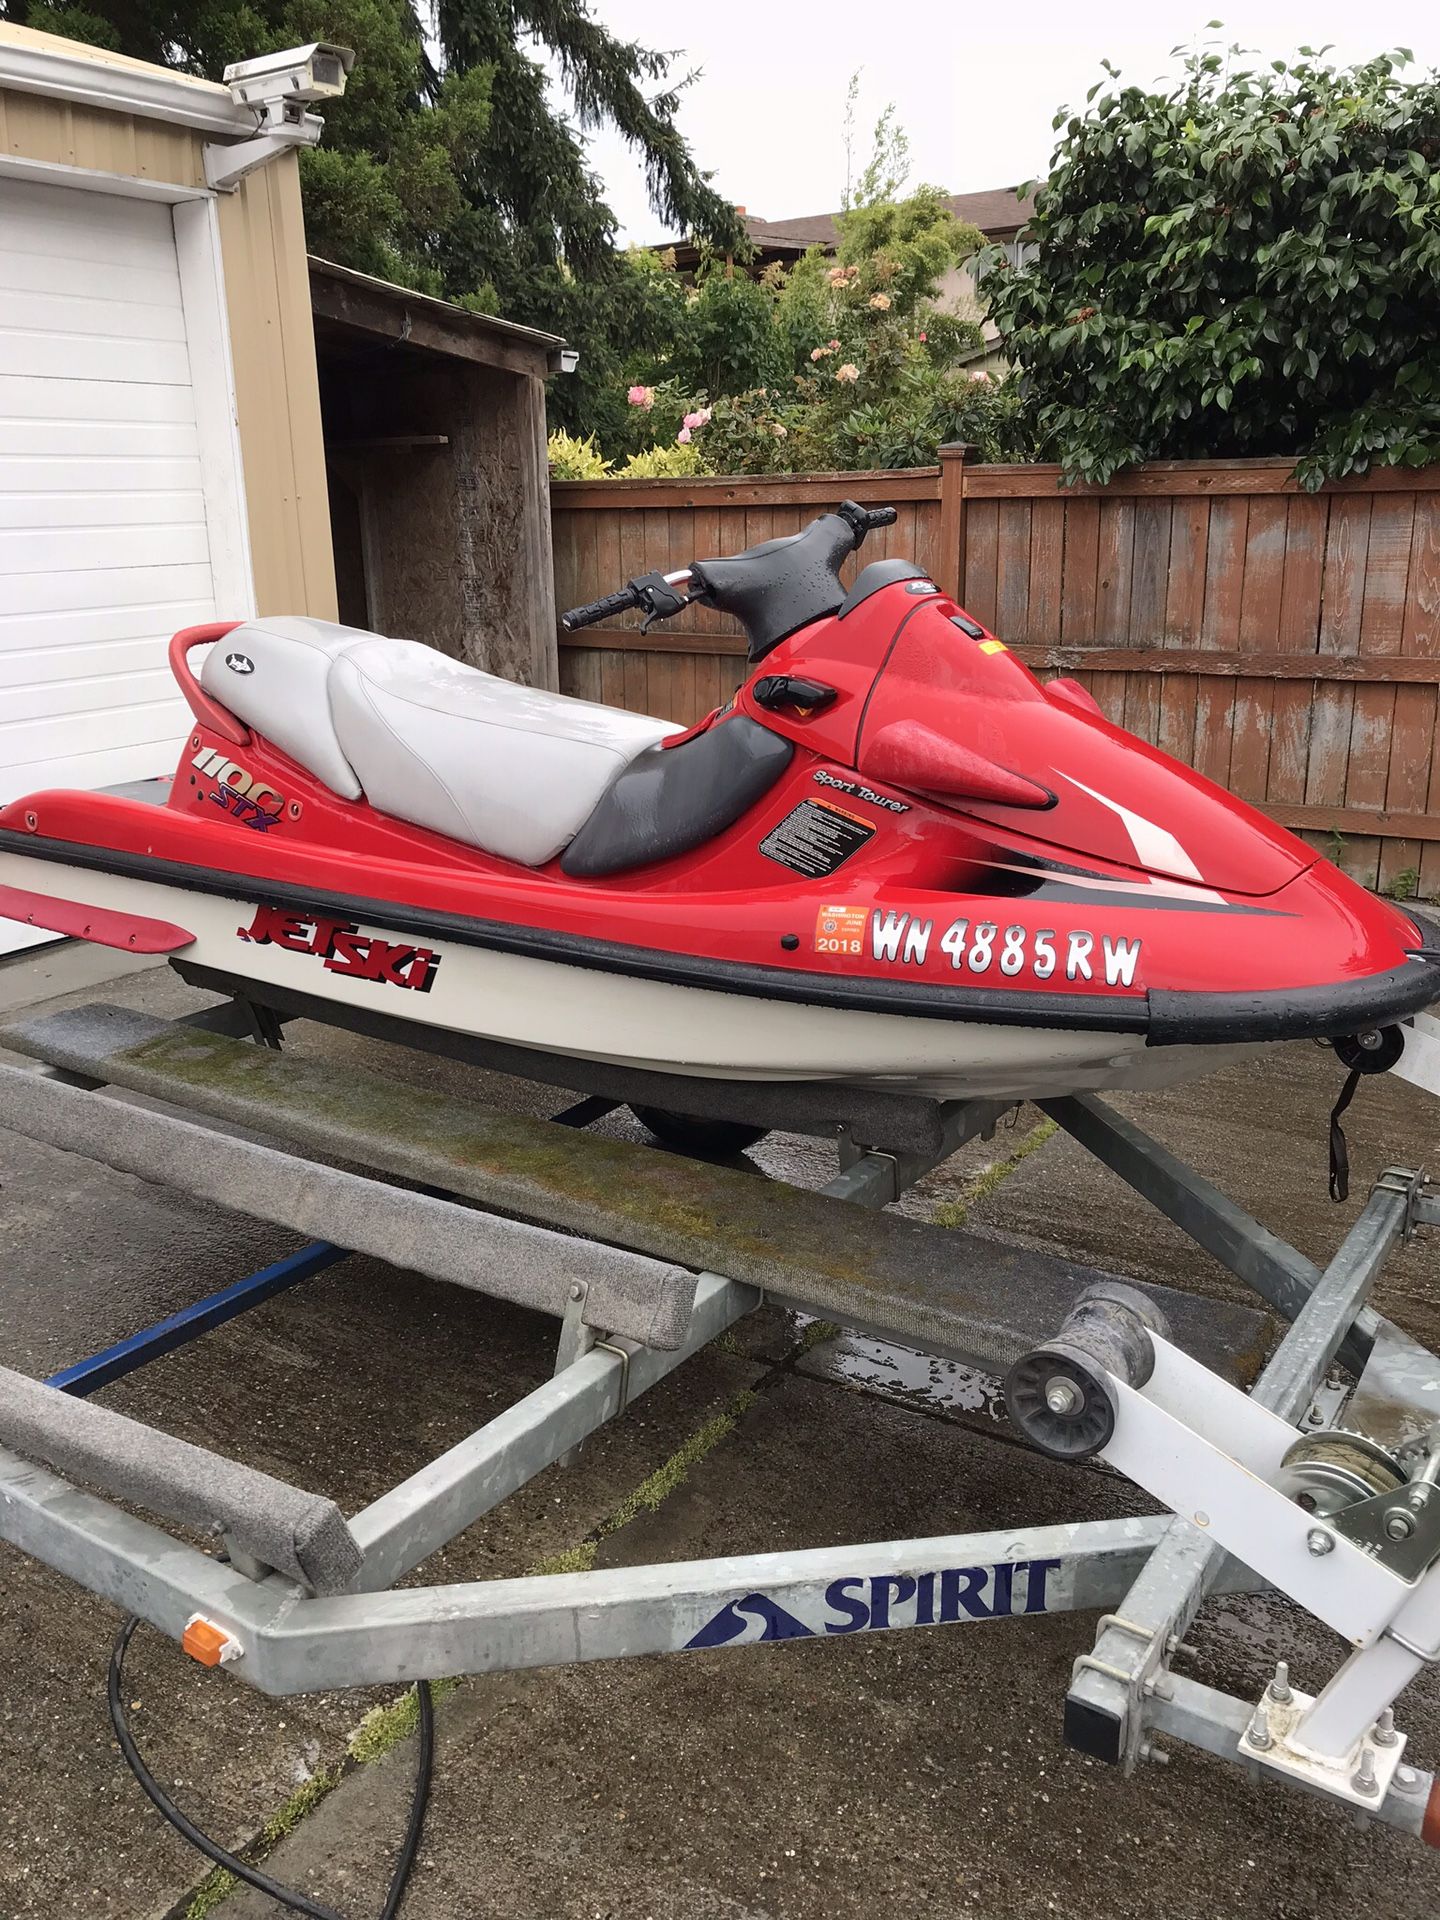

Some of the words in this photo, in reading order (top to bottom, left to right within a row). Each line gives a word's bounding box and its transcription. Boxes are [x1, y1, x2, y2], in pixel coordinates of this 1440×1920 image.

[209, 782, 281, 832] STX
[813, 769, 856, 793] Sport
[857, 786, 910, 813] Tourer
[817, 938, 861, 953] 2018
[871, 908, 933, 966] WN
[824, 1558, 1062, 1634] SPIRIT
